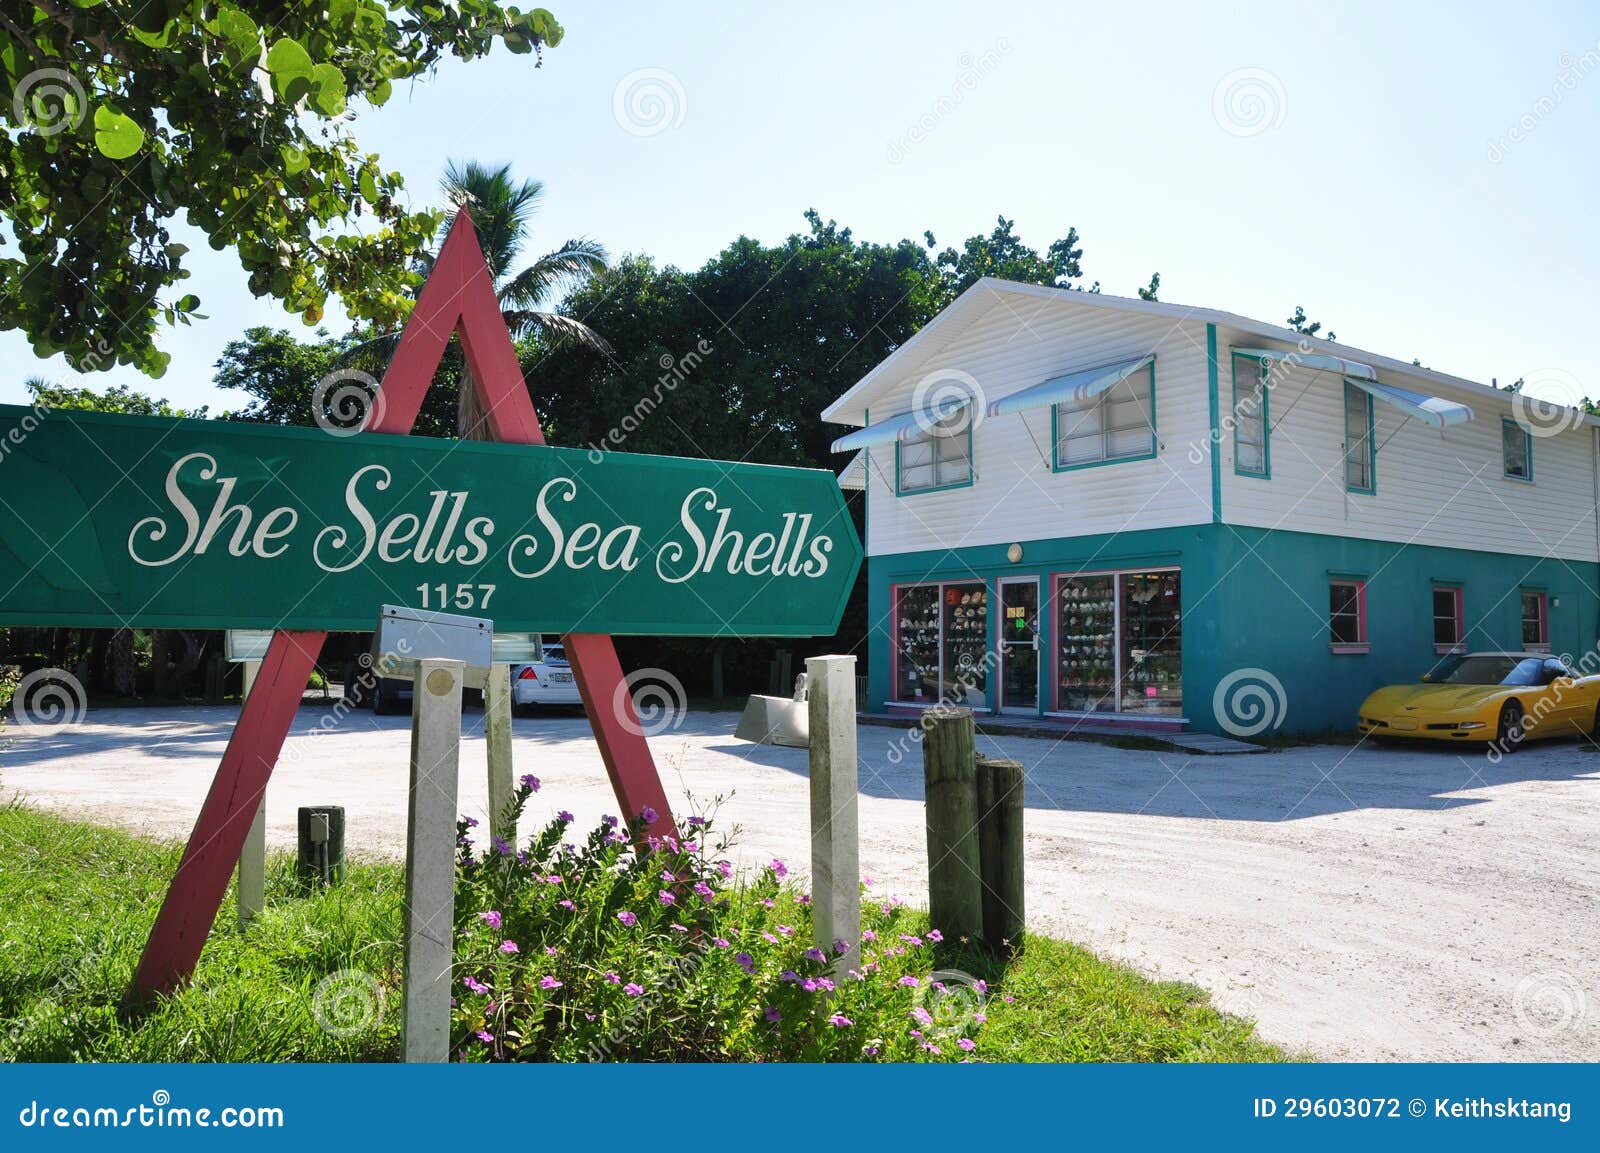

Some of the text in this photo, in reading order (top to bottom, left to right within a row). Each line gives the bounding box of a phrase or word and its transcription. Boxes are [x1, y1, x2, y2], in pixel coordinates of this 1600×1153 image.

[128, 453, 834, 584] She Sells Sea Shells
[416, 583, 496, 610] 1157
